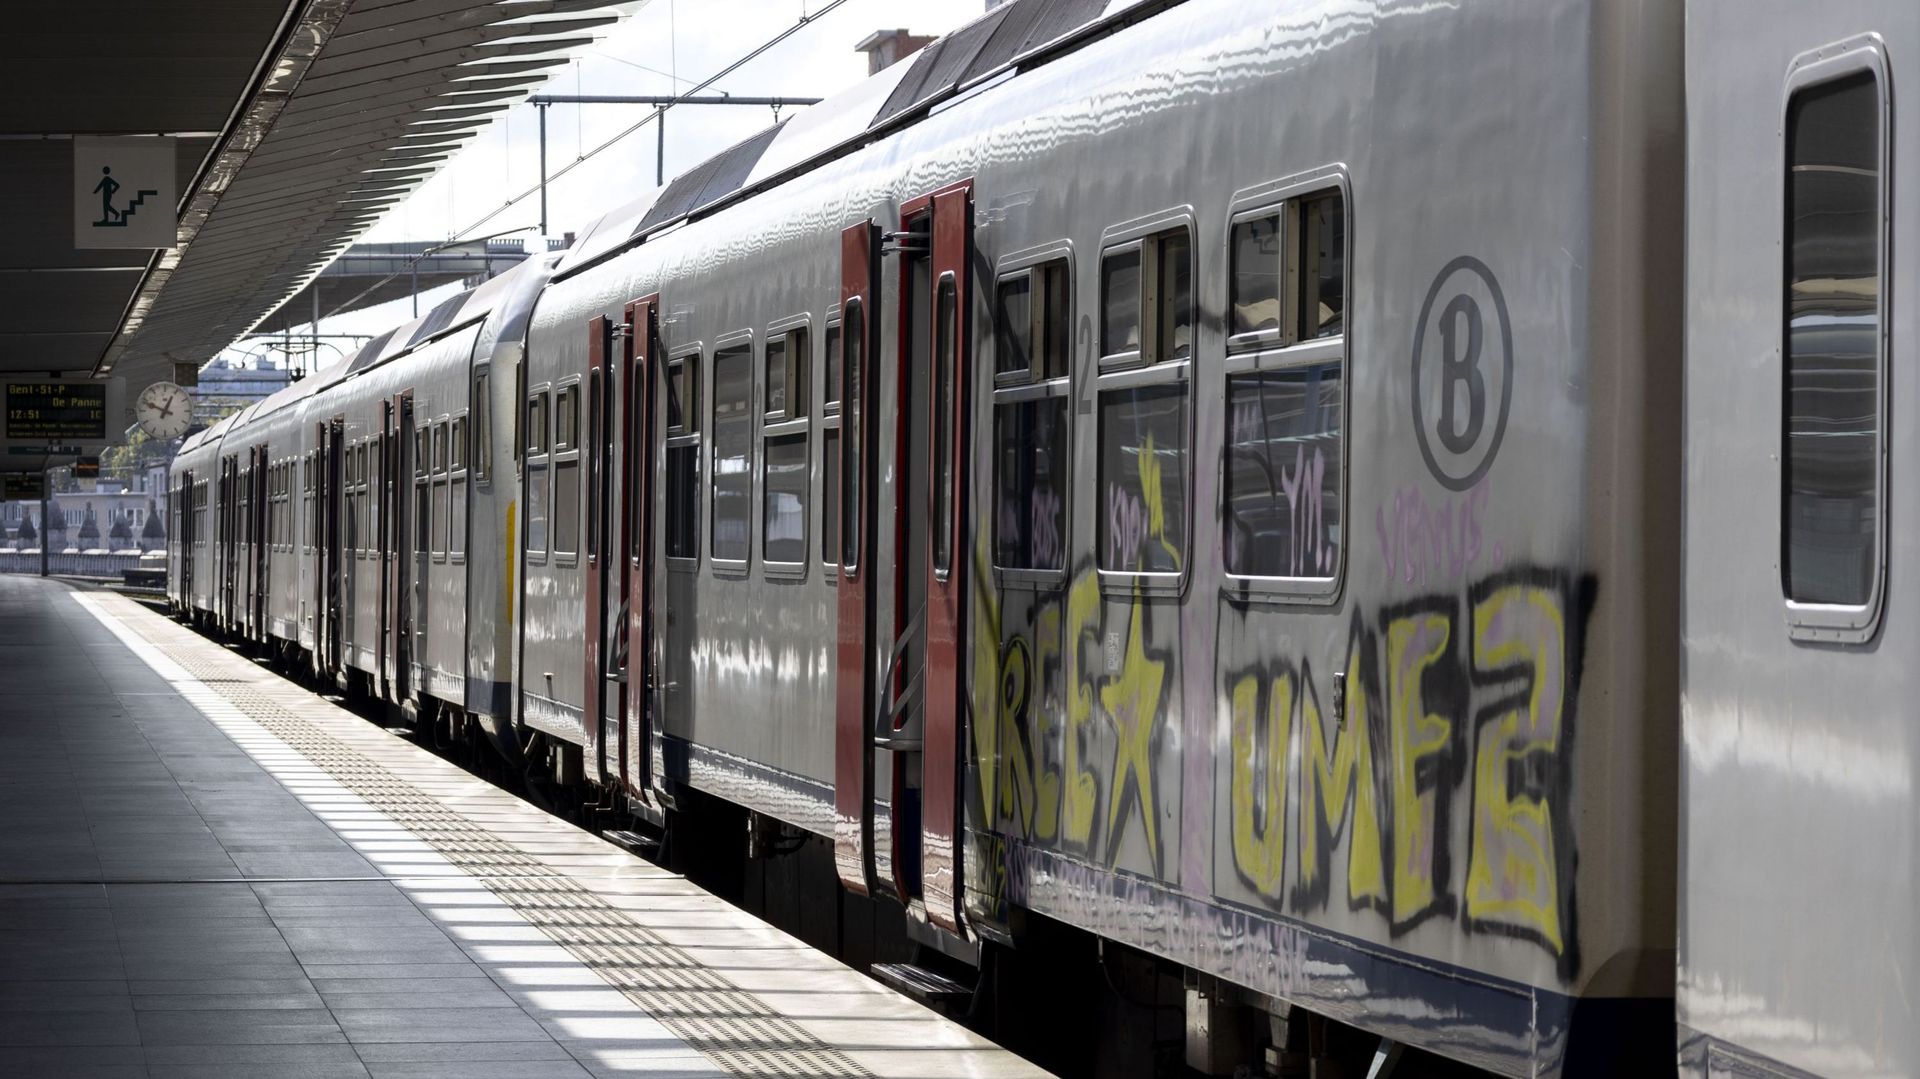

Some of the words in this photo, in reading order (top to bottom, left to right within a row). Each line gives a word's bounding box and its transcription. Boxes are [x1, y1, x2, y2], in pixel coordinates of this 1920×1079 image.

[1078, 313, 1092, 415] 2
[52, 397, 65, 407] De
[71, 397, 102, 407] Panne
[10, 409, 40, 419] 12:51
